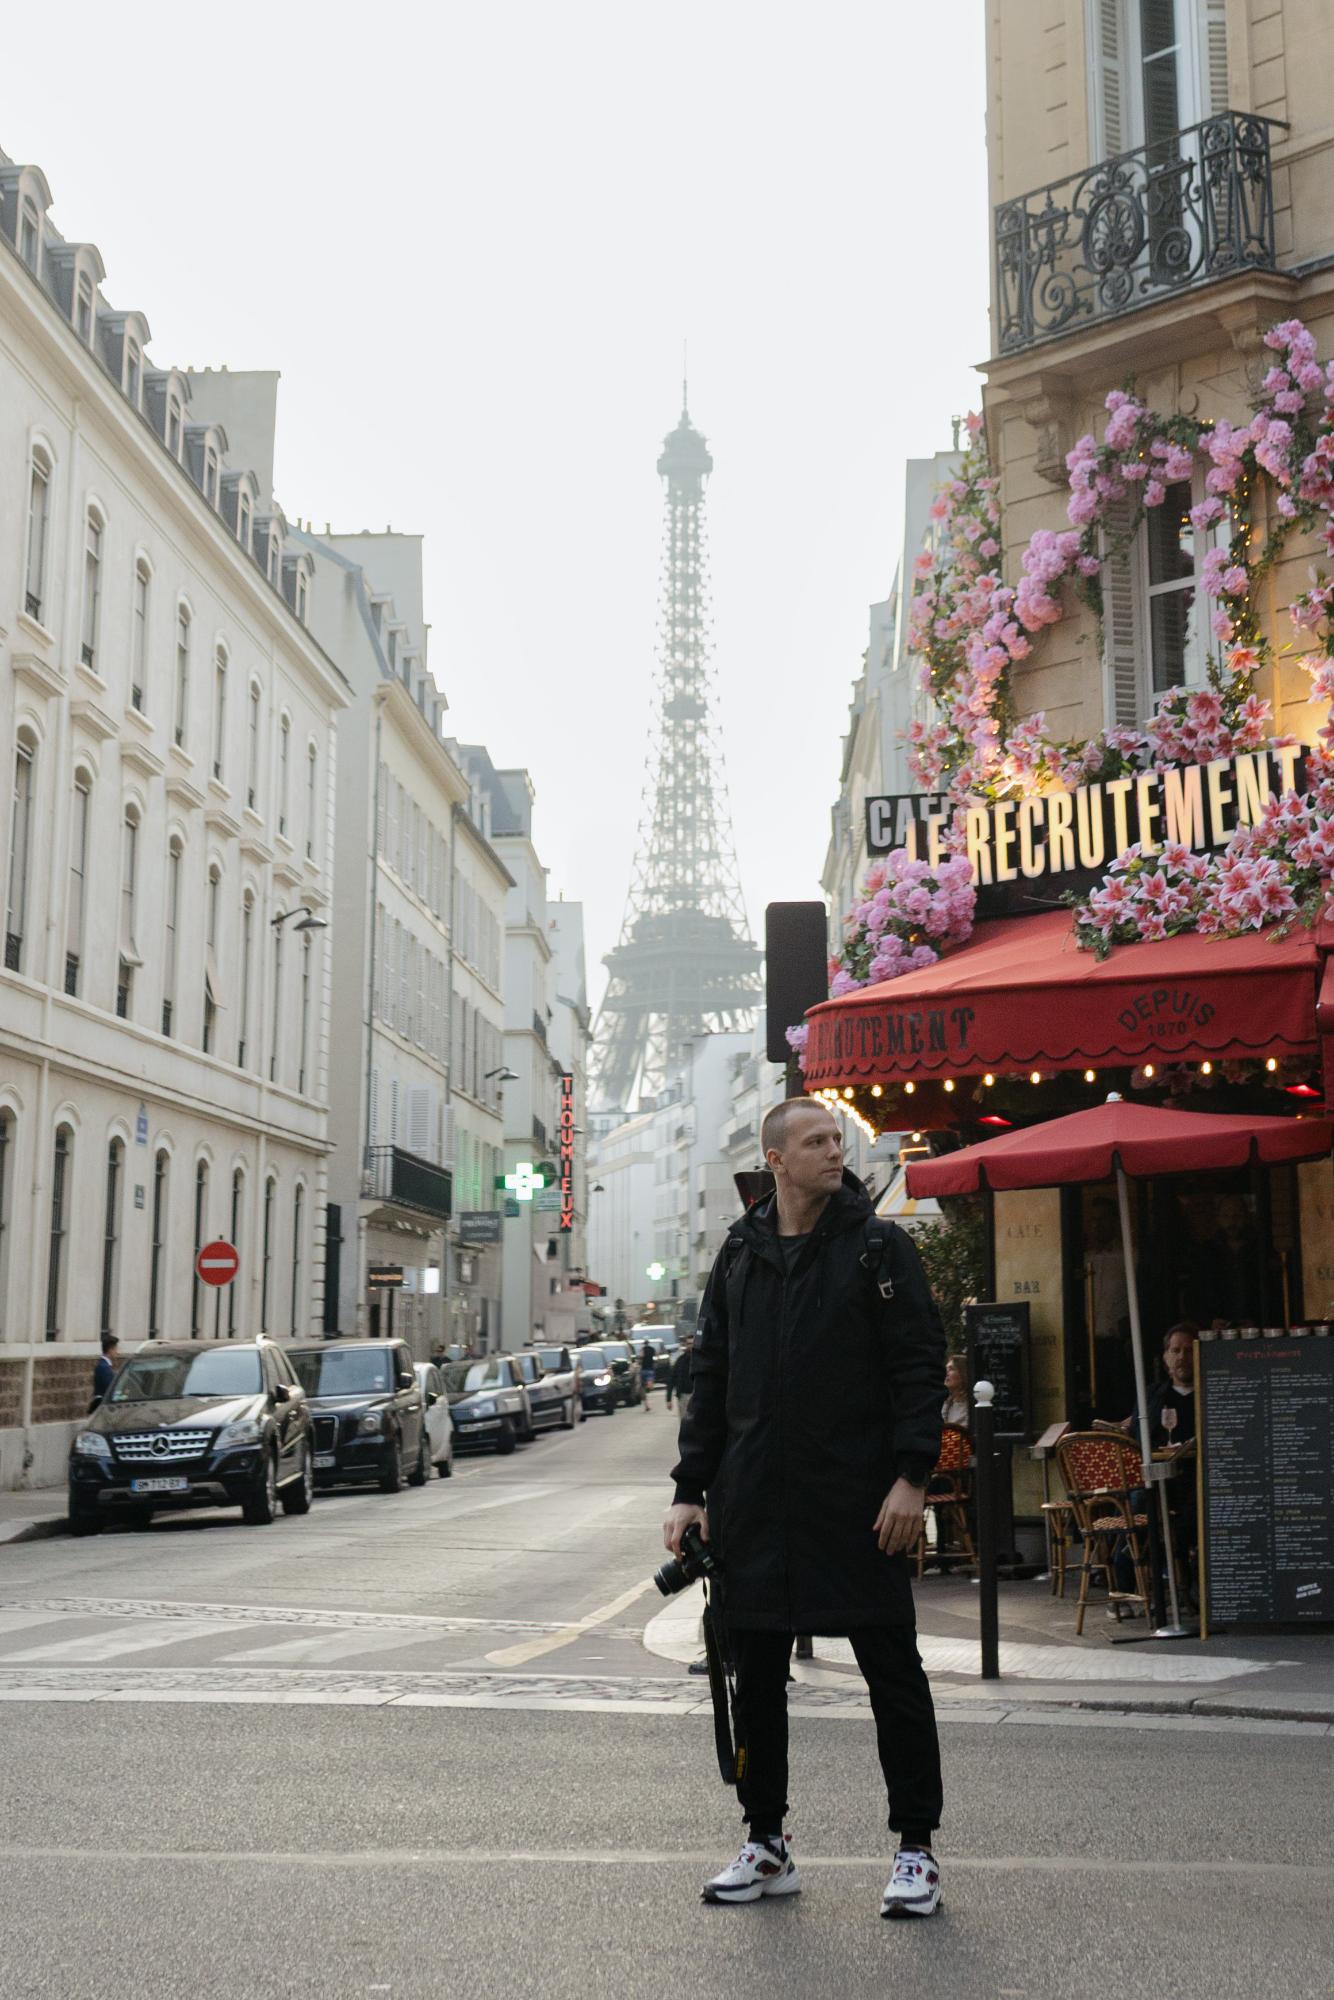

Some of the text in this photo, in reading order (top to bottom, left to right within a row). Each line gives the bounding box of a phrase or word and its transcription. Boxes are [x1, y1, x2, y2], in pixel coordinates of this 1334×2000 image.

[966, 744, 1301, 887] RECRUTEMENT
[1118, 989, 1215, 1032] DEPUIS
[561, 1076, 574, 1228] THOUMIEUX
[1014, 1281, 1040, 1294] BAR
